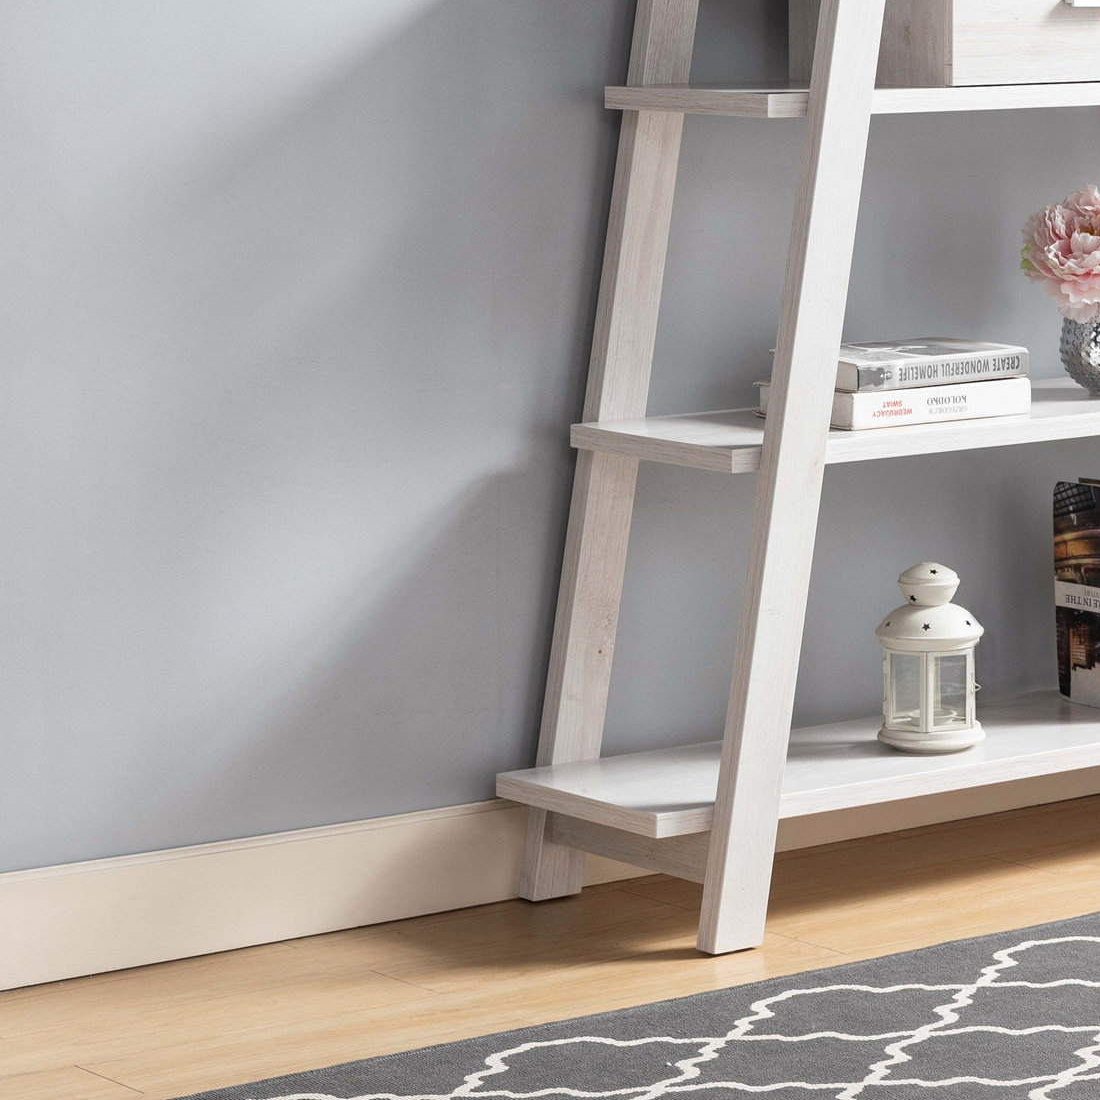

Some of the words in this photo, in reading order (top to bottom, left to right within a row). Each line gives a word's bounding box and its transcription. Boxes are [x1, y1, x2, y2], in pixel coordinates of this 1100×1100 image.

[941, 359, 990, 377] WONDERFUL
[992, 355, 1021, 372] CREATE
[898, 365, 938, 381] HOMELIFE
[1064, 594, 1083, 606] THE
[1082, 597, 1092, 608] IN
